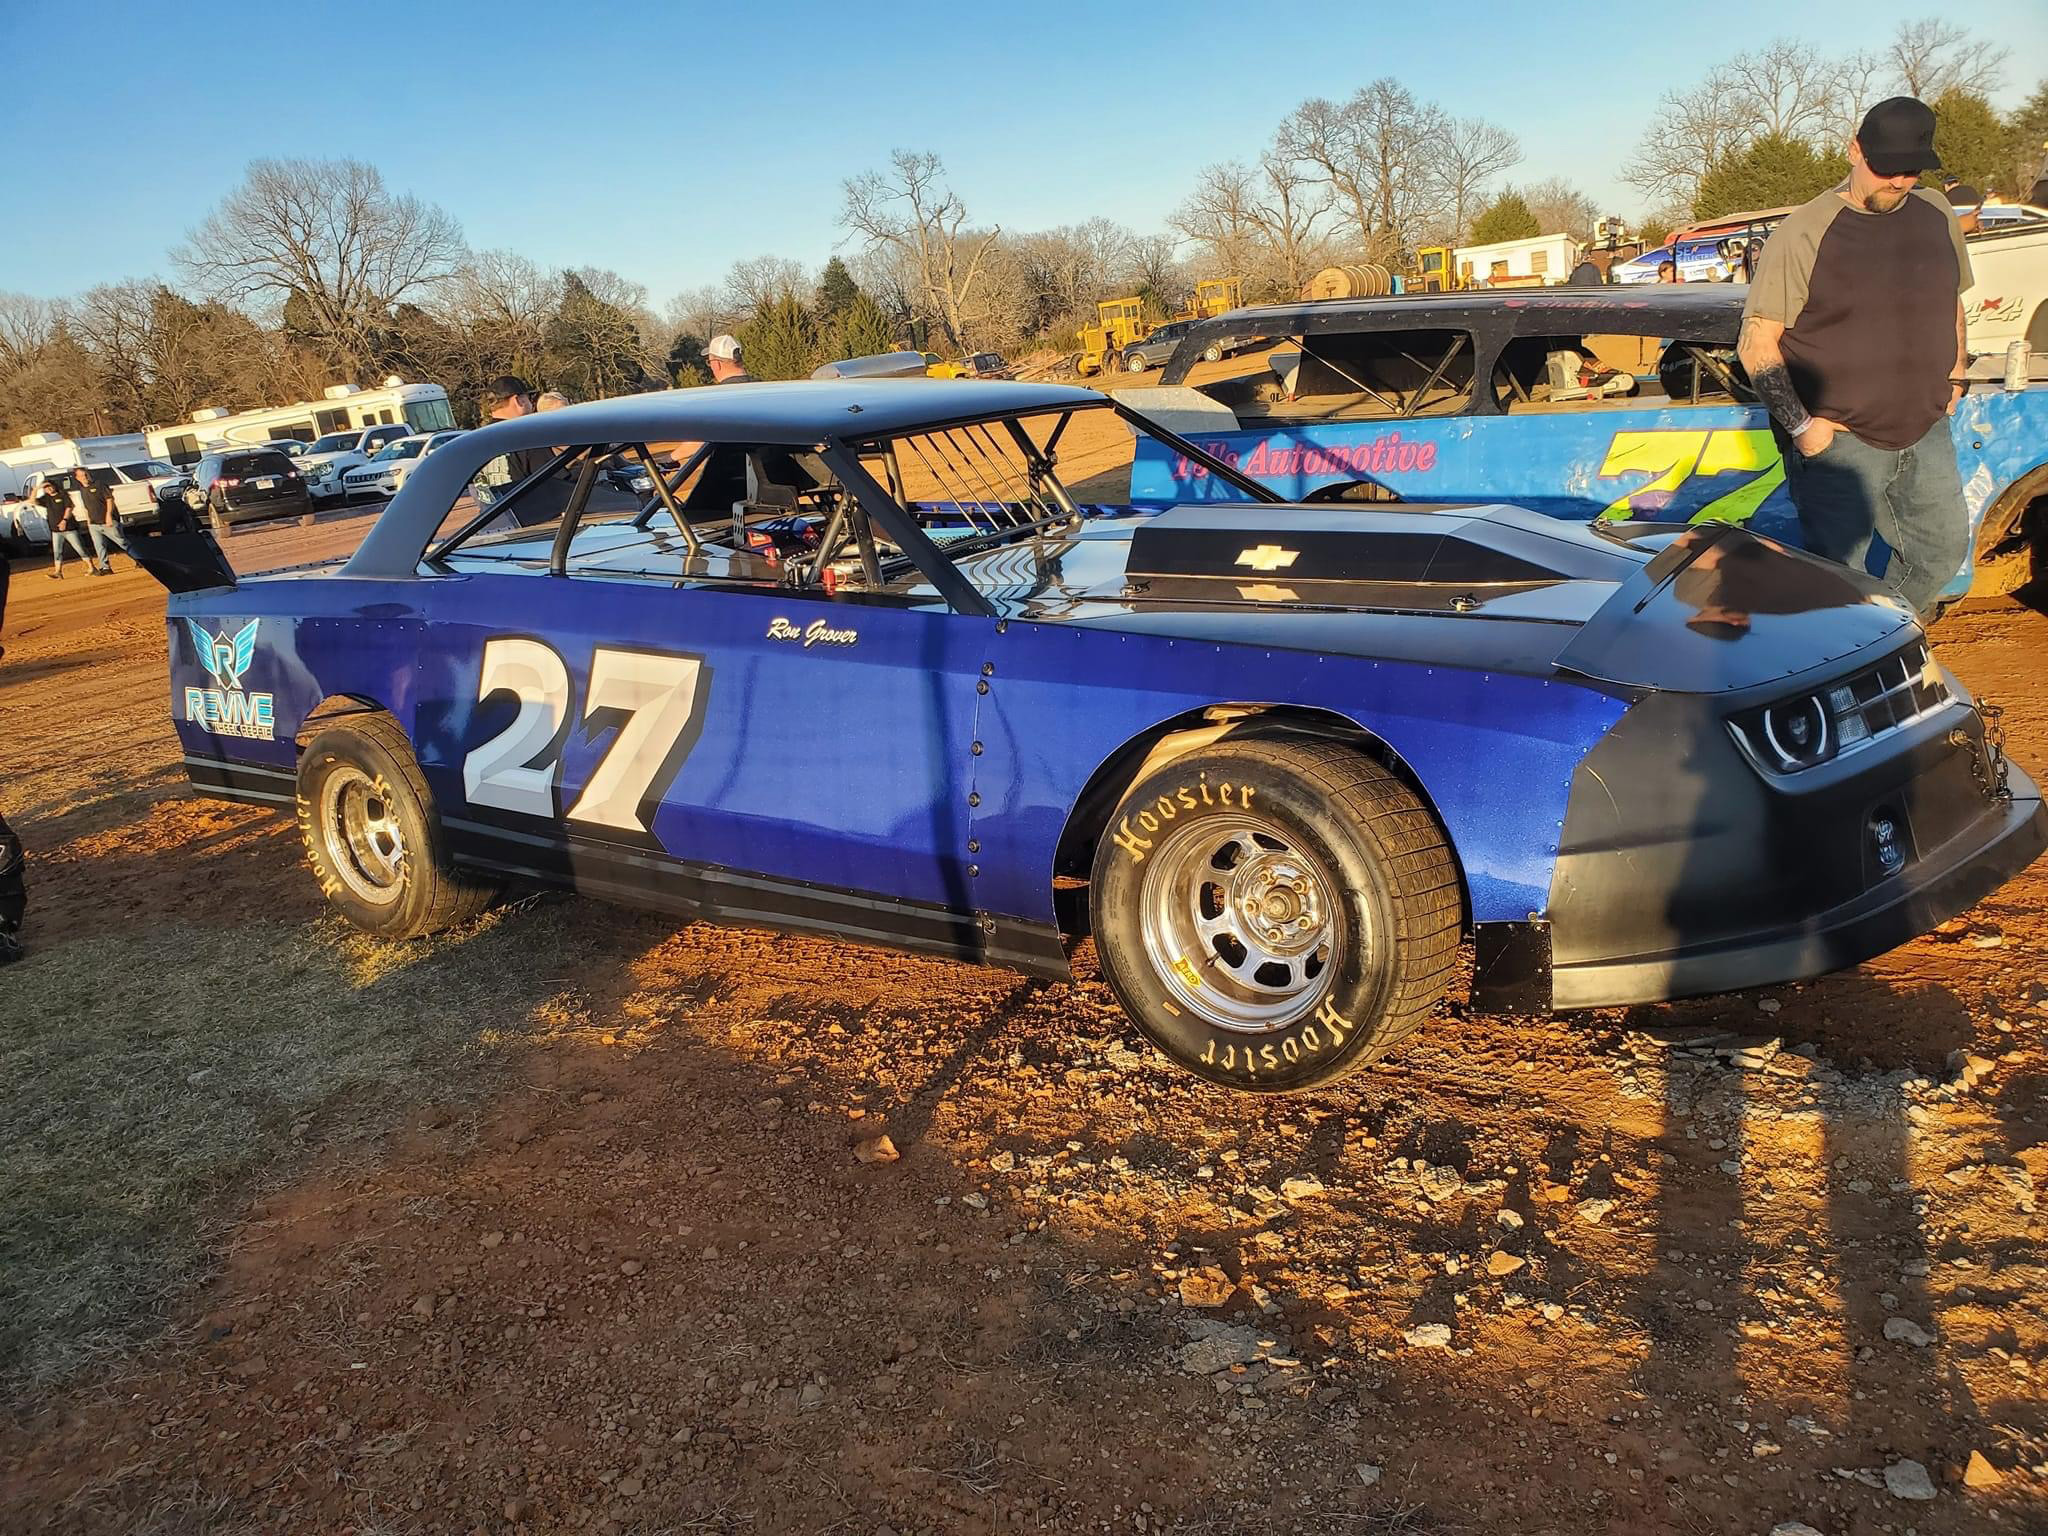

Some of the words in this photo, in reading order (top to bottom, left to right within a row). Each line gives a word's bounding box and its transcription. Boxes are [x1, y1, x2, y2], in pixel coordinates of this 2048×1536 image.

[1243, 430, 1438, 478] Automotive
[1591, 428, 1788, 528] 77
[766, 617, 801, 641] Ron
[803, 618, 858, 648] Grover
[184, 686, 275, 734] REVIVE
[461, 636, 710, 836] 27
[1112, 772, 1256, 864] Hoosier
[1199, 993, 1354, 1080] Hoosier
